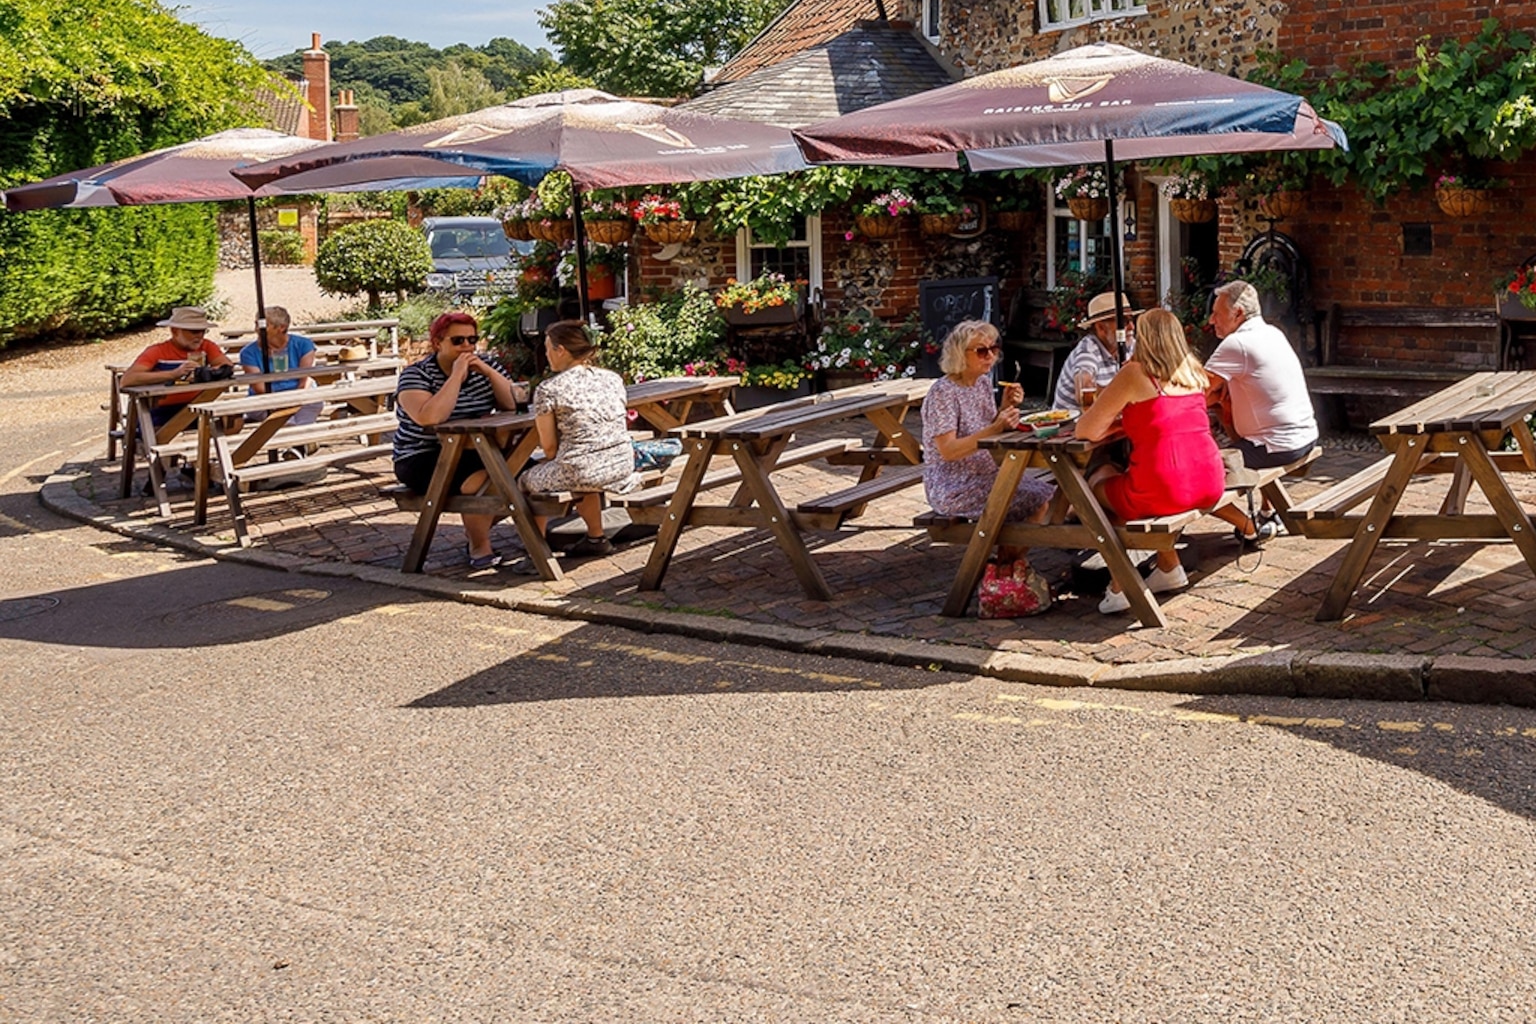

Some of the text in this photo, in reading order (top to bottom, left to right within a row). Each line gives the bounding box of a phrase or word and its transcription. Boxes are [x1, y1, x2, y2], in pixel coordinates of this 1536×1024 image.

[983, 104, 1054, 115] RAISING
[1061, 101, 1093, 110] THE
[1099, 99, 1132, 107] BAR
